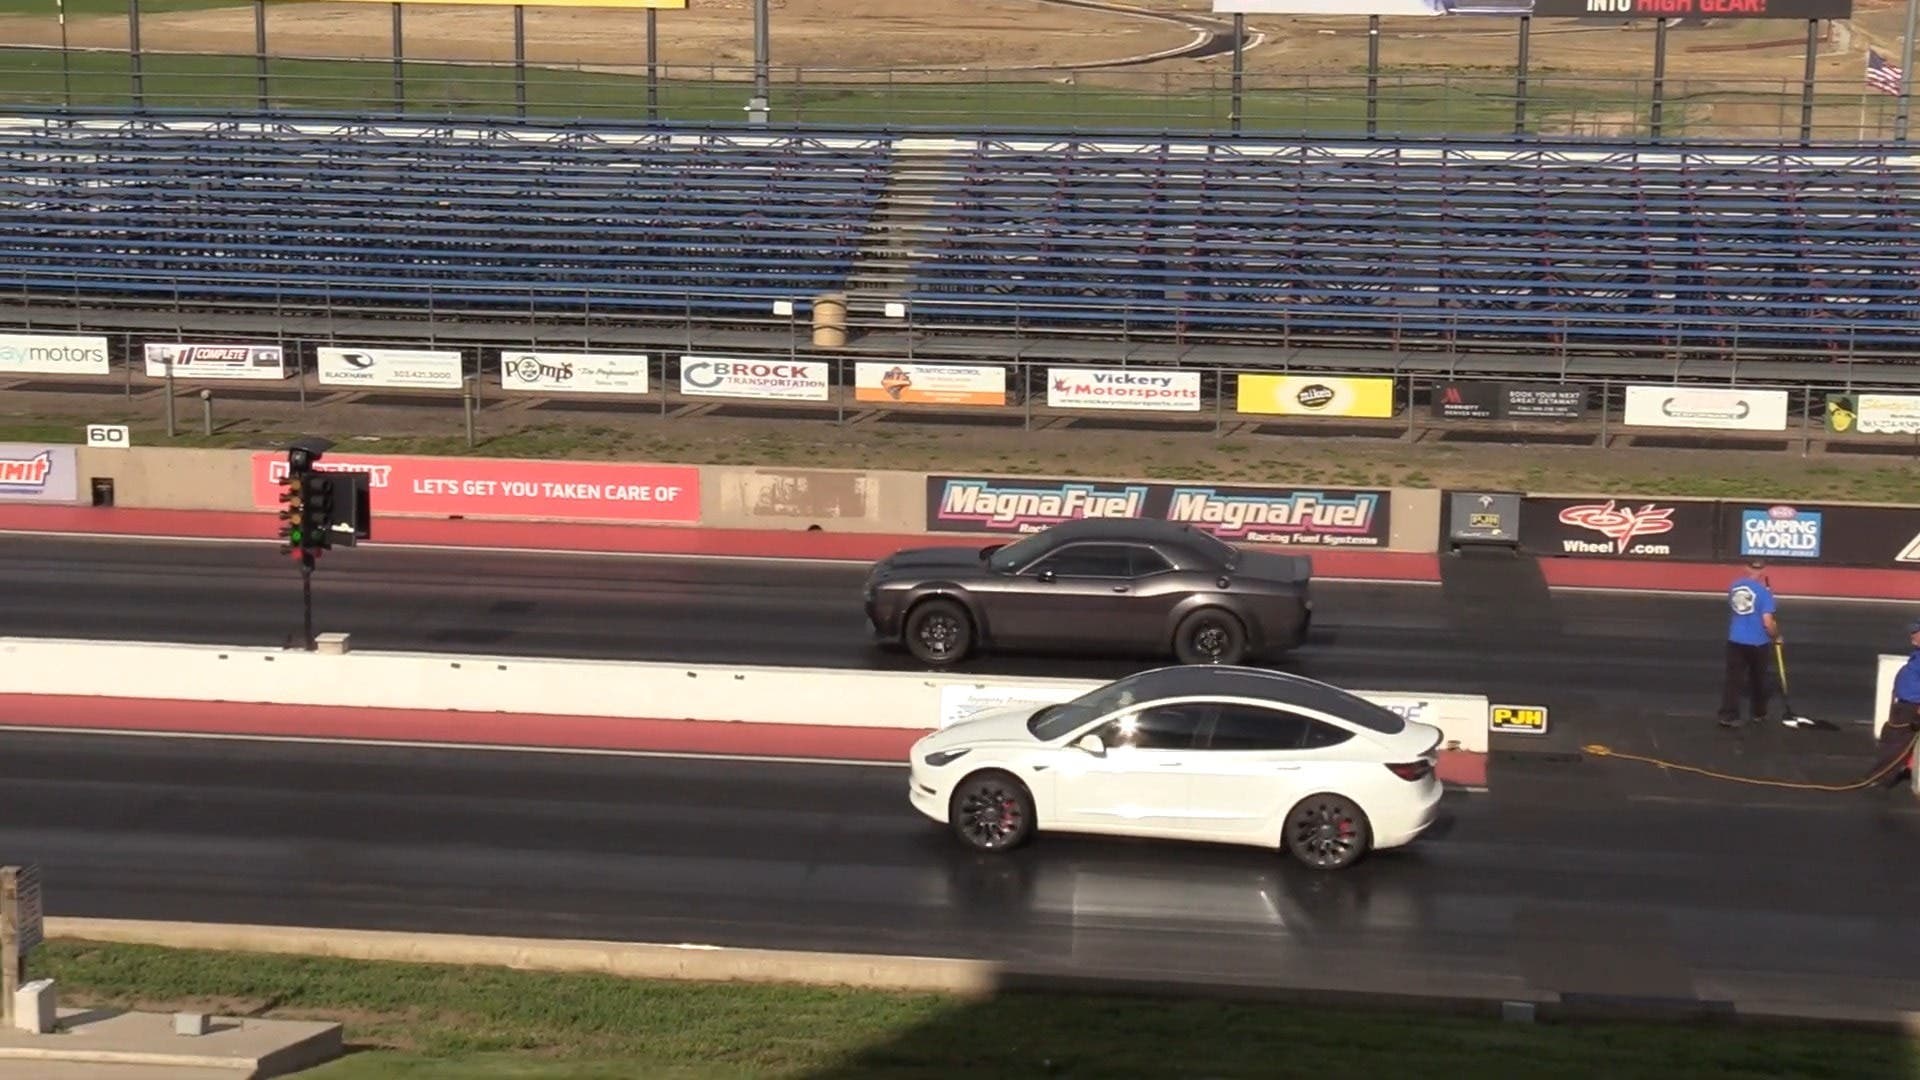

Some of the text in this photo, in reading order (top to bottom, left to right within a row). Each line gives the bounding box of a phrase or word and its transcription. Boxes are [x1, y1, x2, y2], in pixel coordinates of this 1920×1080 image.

[196, 348, 248, 360] COMPLETE
[713, 362, 810, 379] BROCK
[727, 377, 826, 388] TRANSPORTATION
[1093, 373, 1172, 387] Vickery
[1074, 384, 1197, 398] Motorsports
[90, 428, 123, 442] 60
[413, 479, 679, 502] LET'S GET YOU TAKEN CARE OF
[943, 484, 1141, 522] MagnaFuel
[1172, 493, 1371, 530] MagnaFuel
[1745, 518, 1817, 534] CAMPING
[1247, 532, 1379, 546] Racing Fuel Systems
[1745, 531, 1817, 549] WORLD
[1563, 540, 1670, 555] Wheel .com
[1494, 708, 1542, 725] PJH
